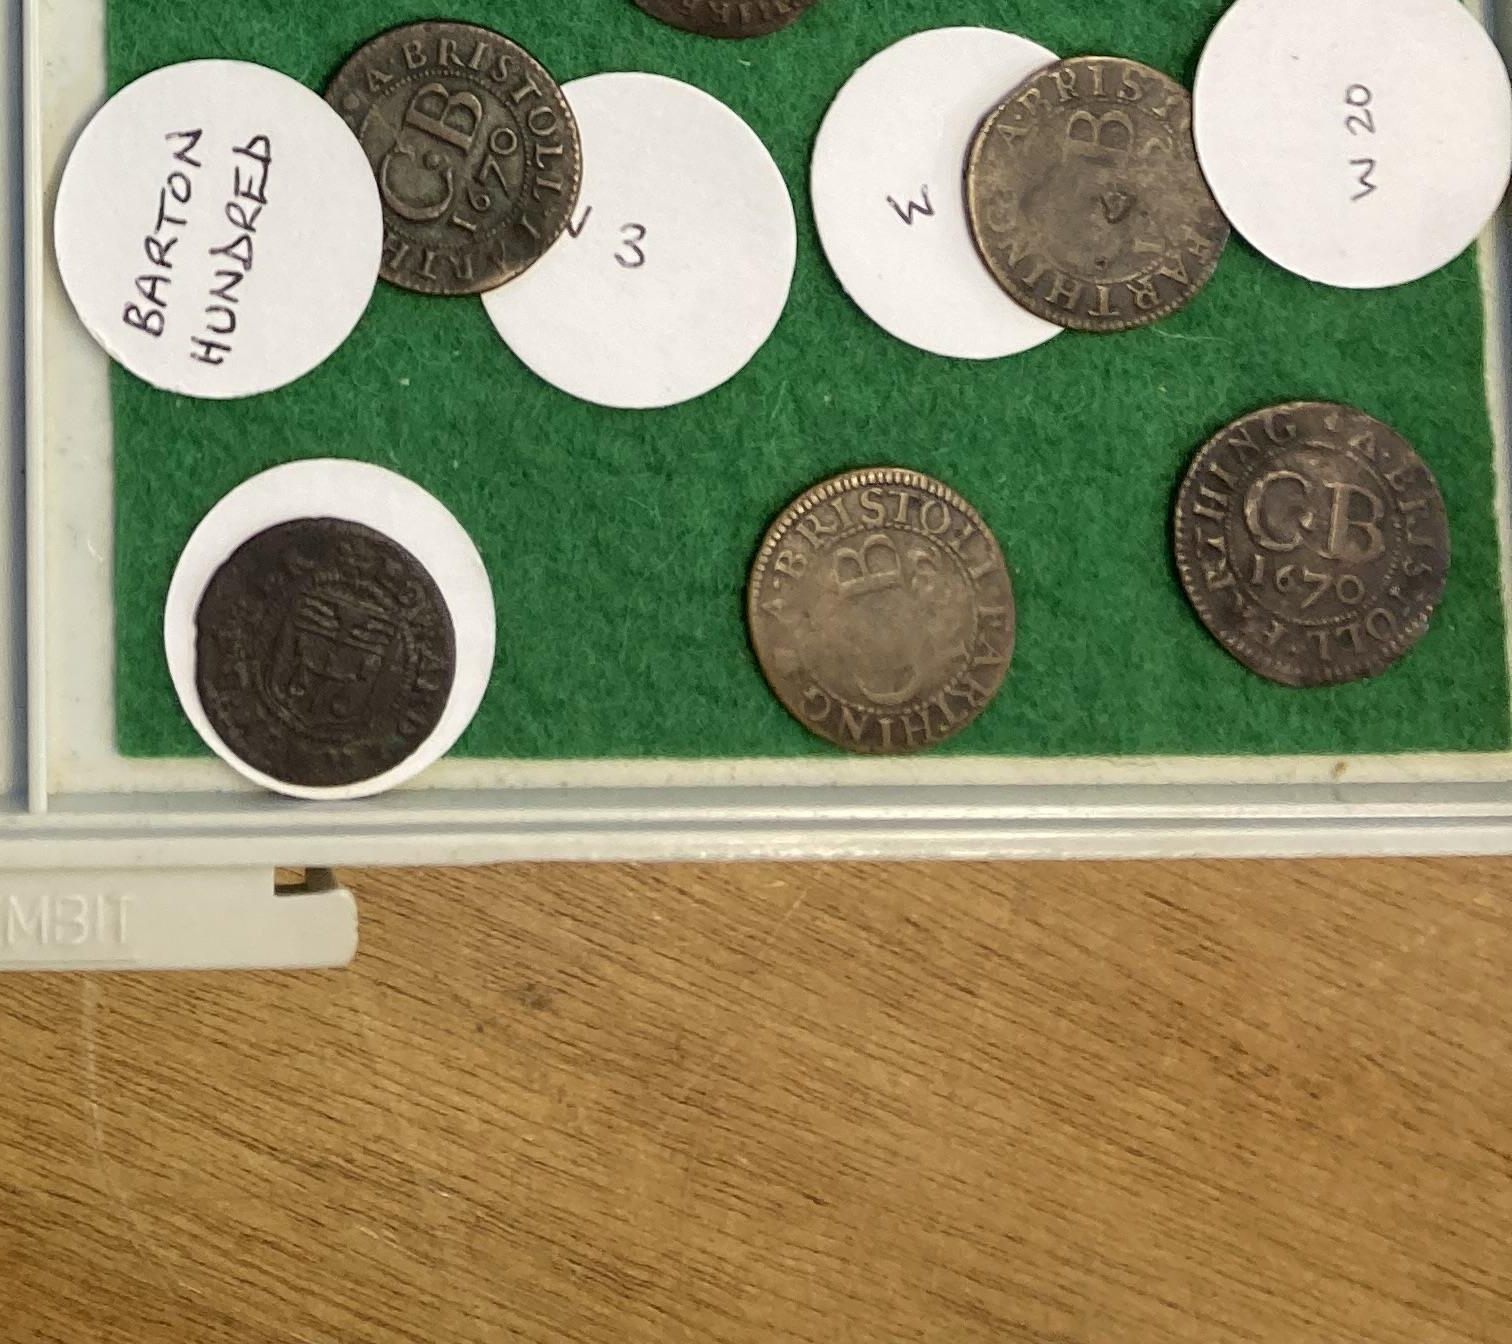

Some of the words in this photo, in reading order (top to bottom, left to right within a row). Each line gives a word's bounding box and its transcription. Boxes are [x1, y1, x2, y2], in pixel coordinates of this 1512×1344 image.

[395, 29, 574, 213] BRISTOLL
[1343, 83, 1376, 136] 20
[886, 186, 936, 226] W
[1349, 157, 1377, 202] W
[122, 126, 205, 340] BARTON
[189, 131, 274, 368] HUNDRED
[613, 222, 647, 269] 3
